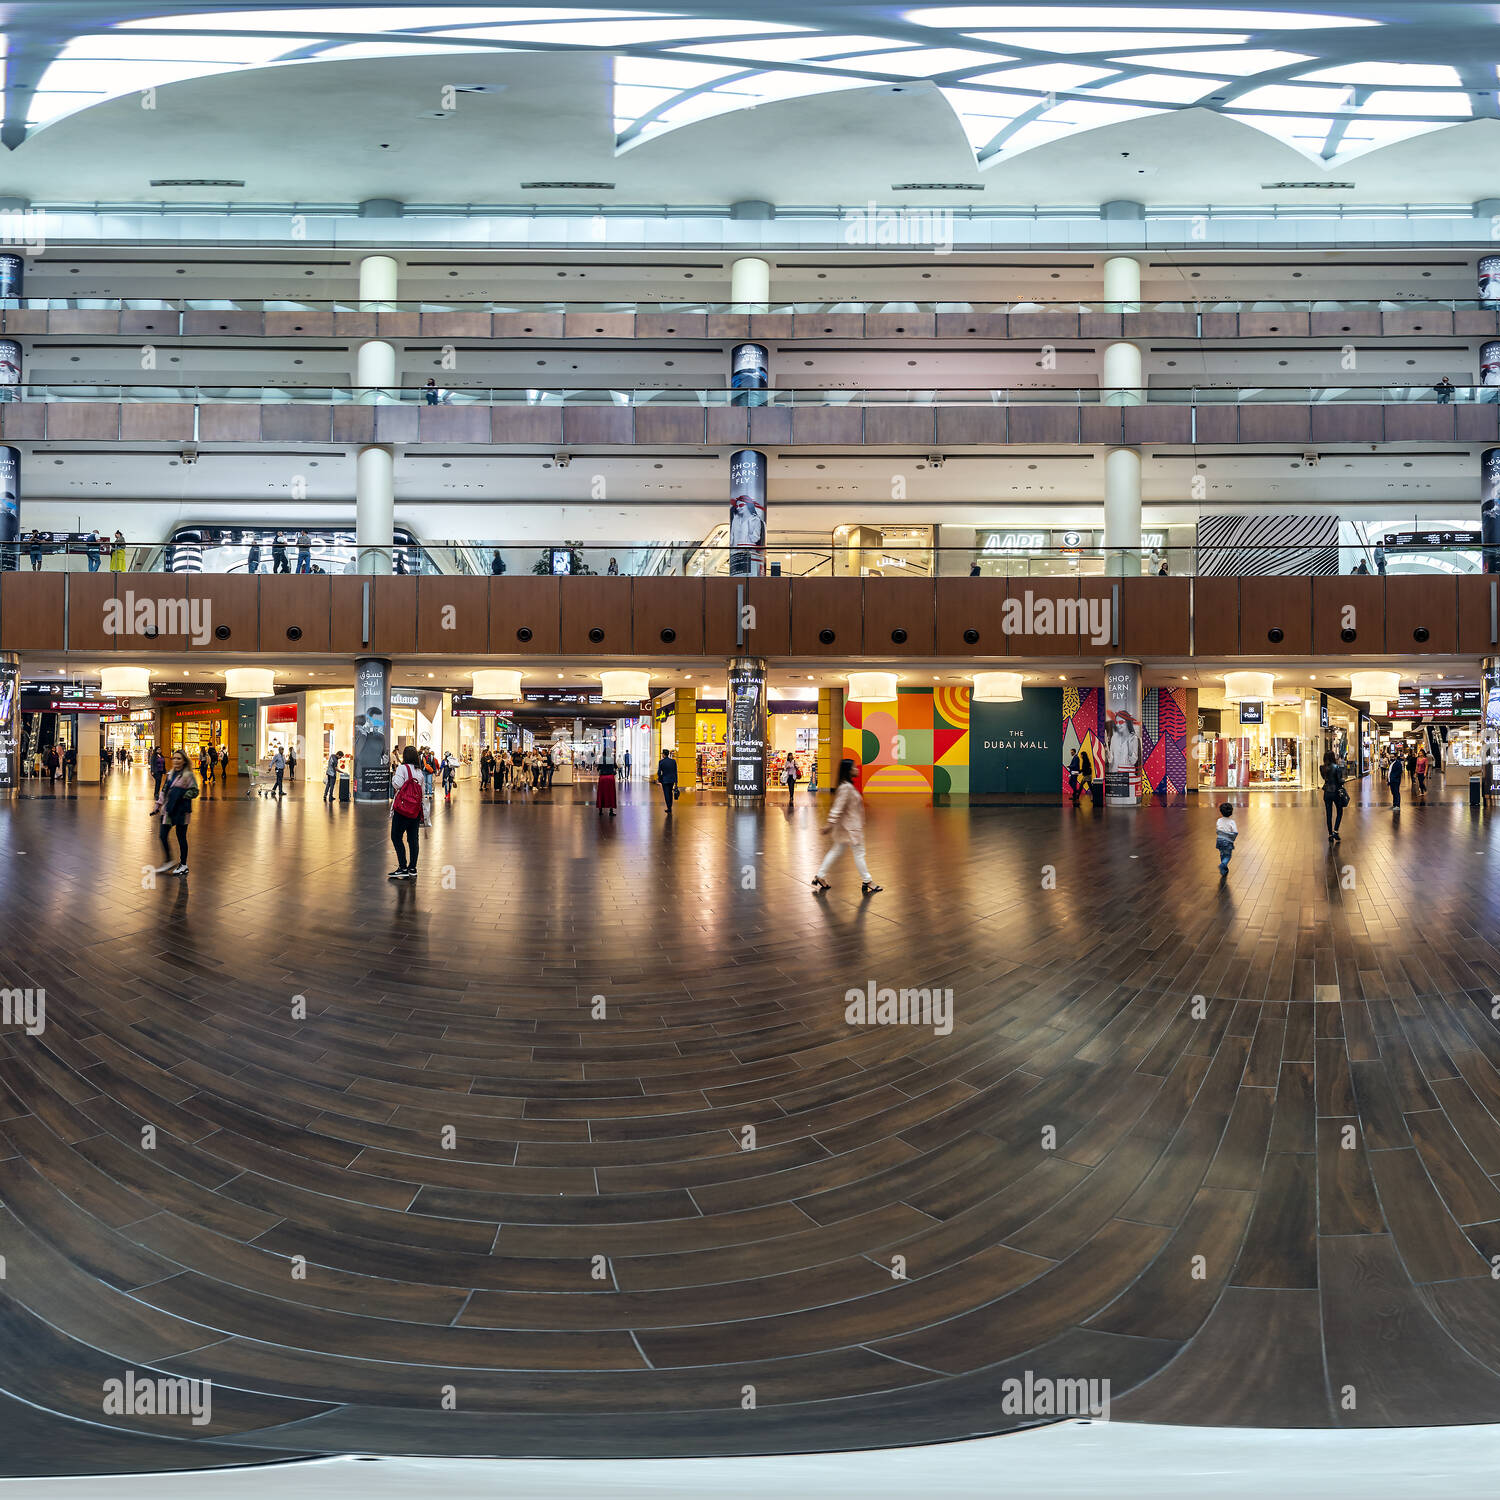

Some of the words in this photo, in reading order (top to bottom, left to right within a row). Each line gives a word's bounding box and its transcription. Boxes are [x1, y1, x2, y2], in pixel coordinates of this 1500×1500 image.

[116, 699, 129, 708] LG
[639, 703, 652, 711] LG
[983, 741, 1016, 749] DUBAI
[1020, 741, 1048, 749] MALL
